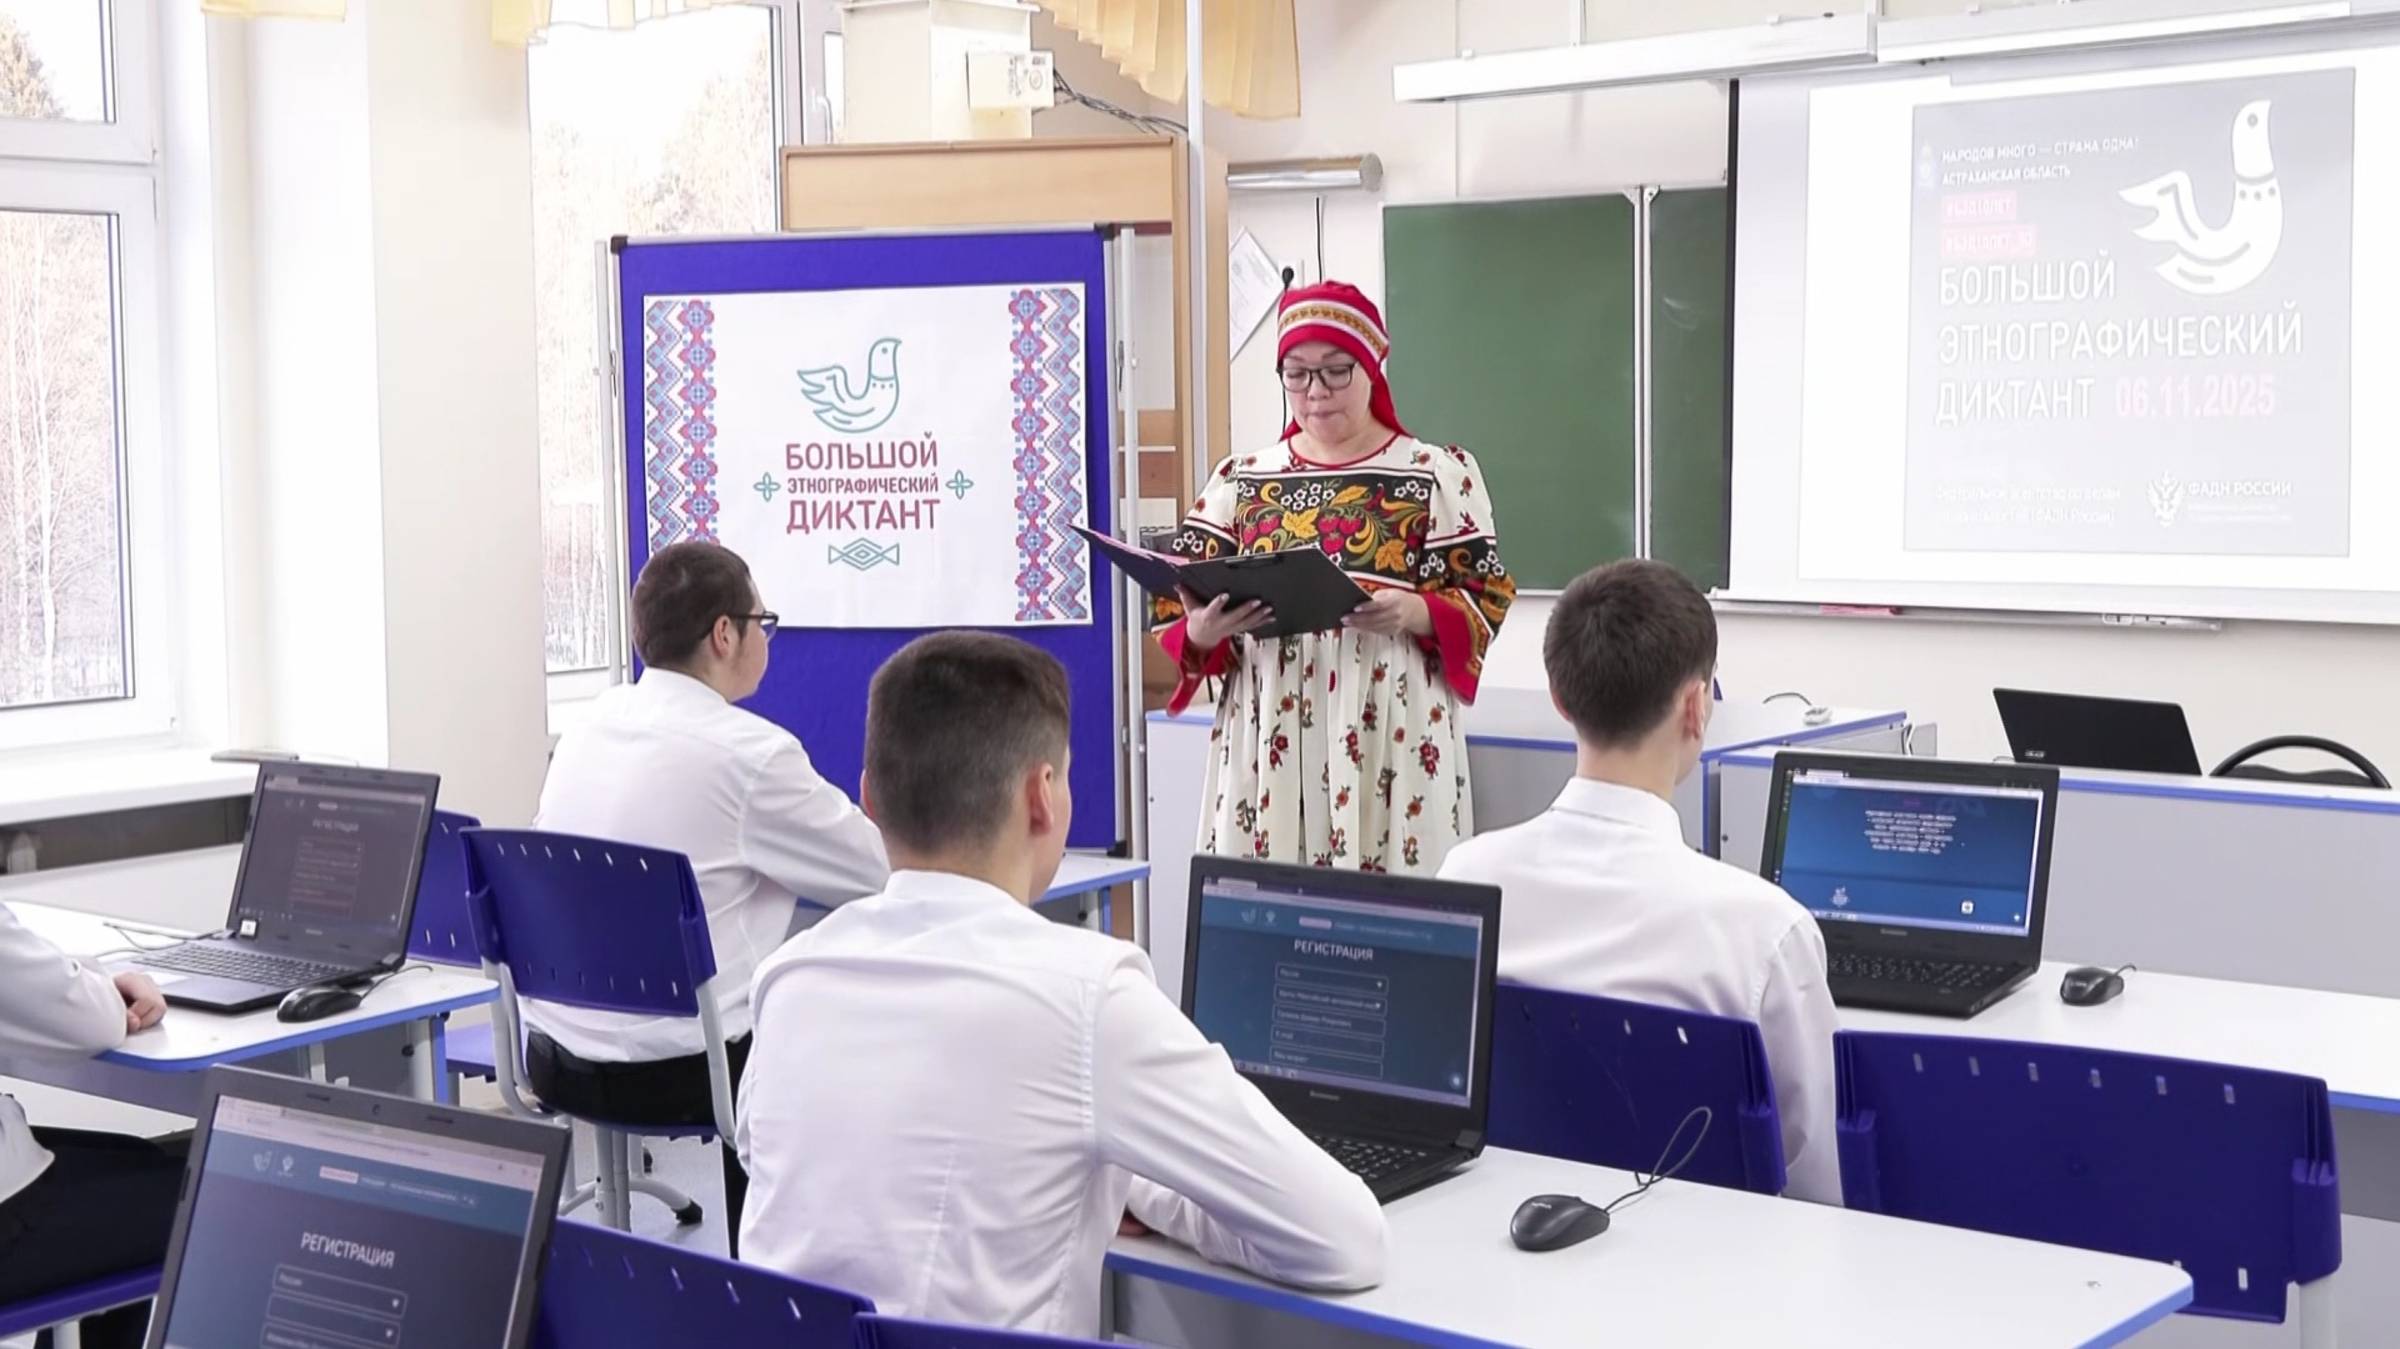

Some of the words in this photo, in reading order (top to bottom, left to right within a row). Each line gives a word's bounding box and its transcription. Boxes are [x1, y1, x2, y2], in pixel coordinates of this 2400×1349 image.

[1941, 148, 1995, 163] НАРОДОВ
[1997, 143, 2036, 159] МНОГО
[2053, 140, 2098, 157] СТРАНА
[1942, 168, 2020, 187] АСТРАХАНСКАЯ
[2022, 164, 2071, 180] ОБЛАСТЬ
[1938, 249, 2116, 306] БОЛЬШОЙ
[1938, 301, 2303, 364] ЭТНОГРАФИЧЕСКИЙ
[1934, 377, 2095, 427] ДИКТАНТ
[2115, 373, 2276, 418] 06.11.2025
[785, 431, 938, 471] БОЛЬШОЙ
[787, 472, 940, 495] ЭТНОГРАФИЧЕСКИЙ
[2188, 481, 2230, 498] ФАДН
[2233, 480, 2292, 496] РОССИИ
[786, 498, 941, 535] ДИКТАНТ
[1293, 938, 1374, 962] РЕГИСТРАЦИЯ
[300, 1230, 396, 1270] РЕГИСТРАЦИЯ
